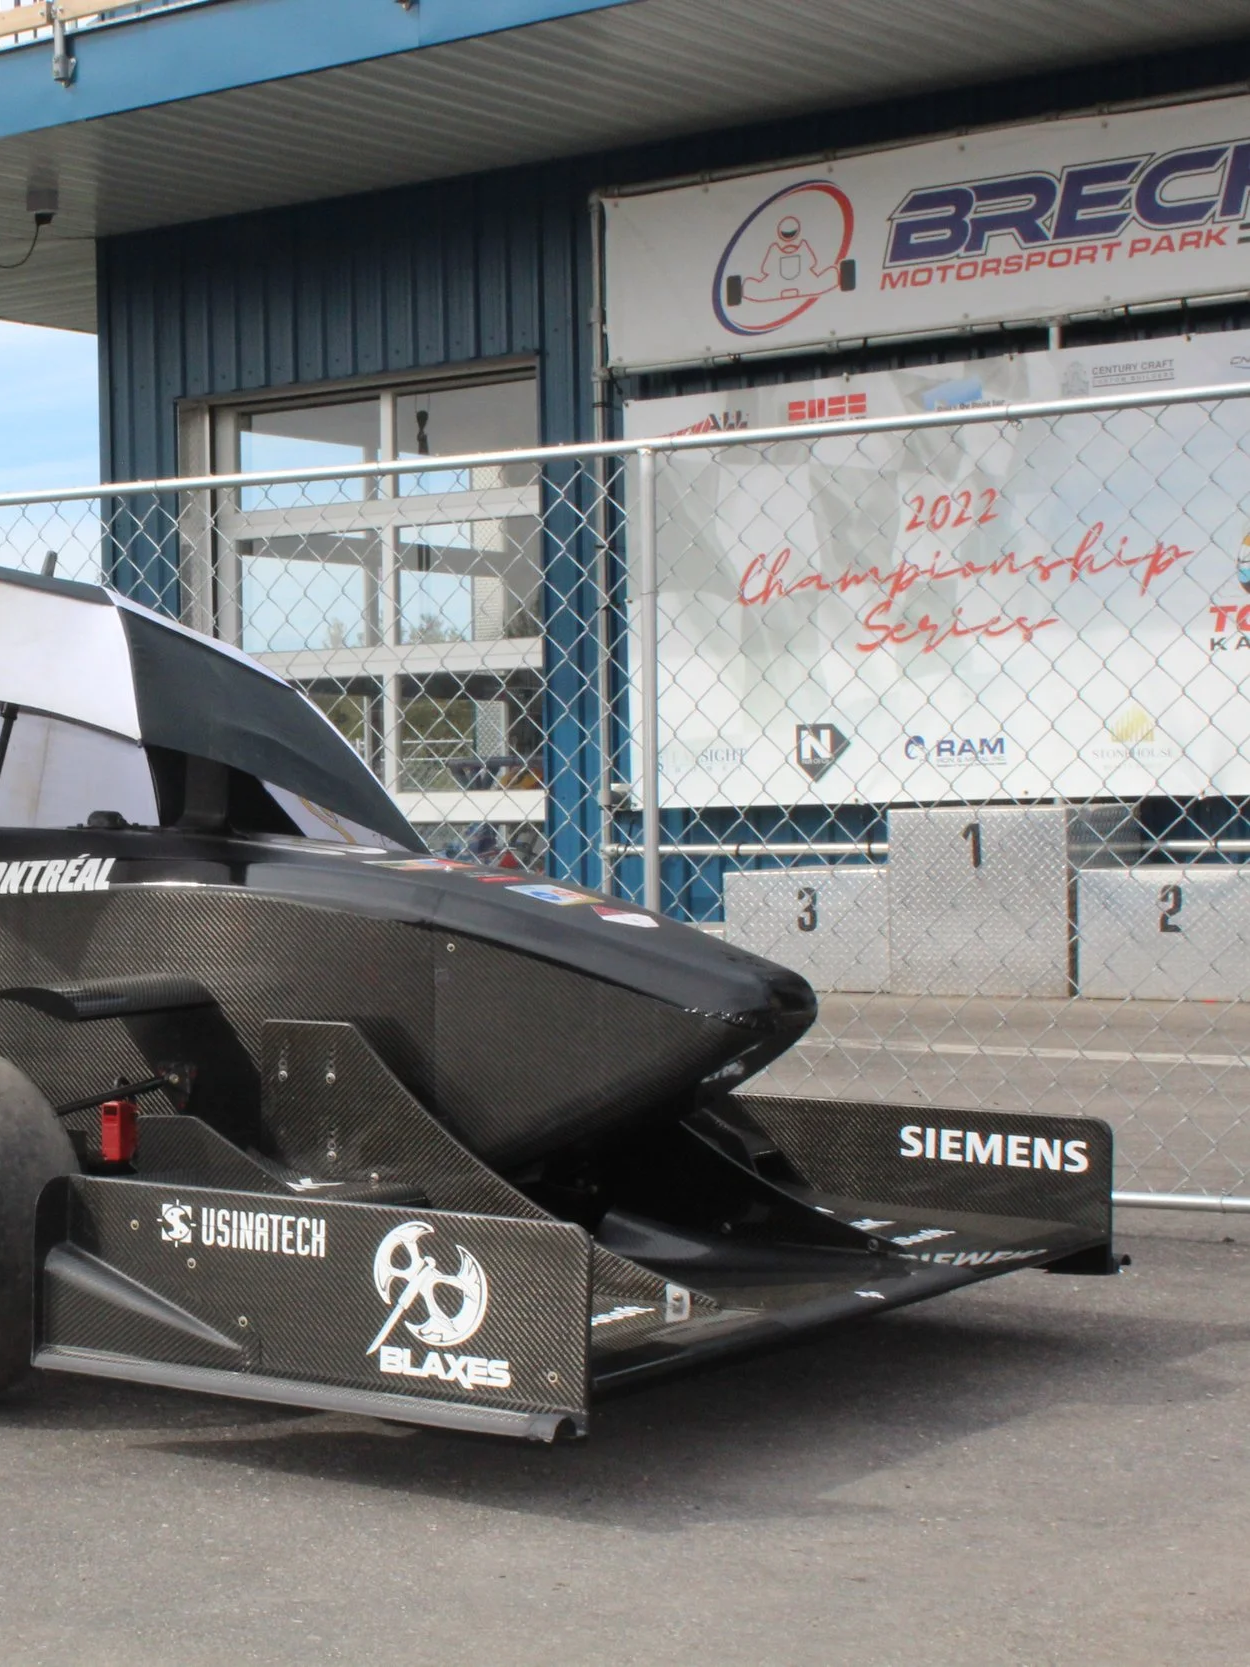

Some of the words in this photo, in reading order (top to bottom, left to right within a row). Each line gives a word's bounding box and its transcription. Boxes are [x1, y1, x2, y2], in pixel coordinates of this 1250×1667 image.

[880, 240, 1122, 291] MOTORSPORT
[1128, 226, 1230, 258] PARK
[1092, 363, 1137, 376] CENTURY
[1141, 359, 1175, 371] CRAFT
[904, 487, 999, 532] 2022
[736, 520, 1195, 606] Championship
[854, 600, 1059, 653] Series
[936, 738, 1005, 757] RAM
[962, 823, 982, 868] 1
[796, 887, 818, 932] 3
[1159, 884, 1184, 933] 2
[899, 1125, 1089, 1173] SIEMENS
[201, 1206, 327, 1258] USINATECH
[379, 1345, 512, 1390] BLAXES
